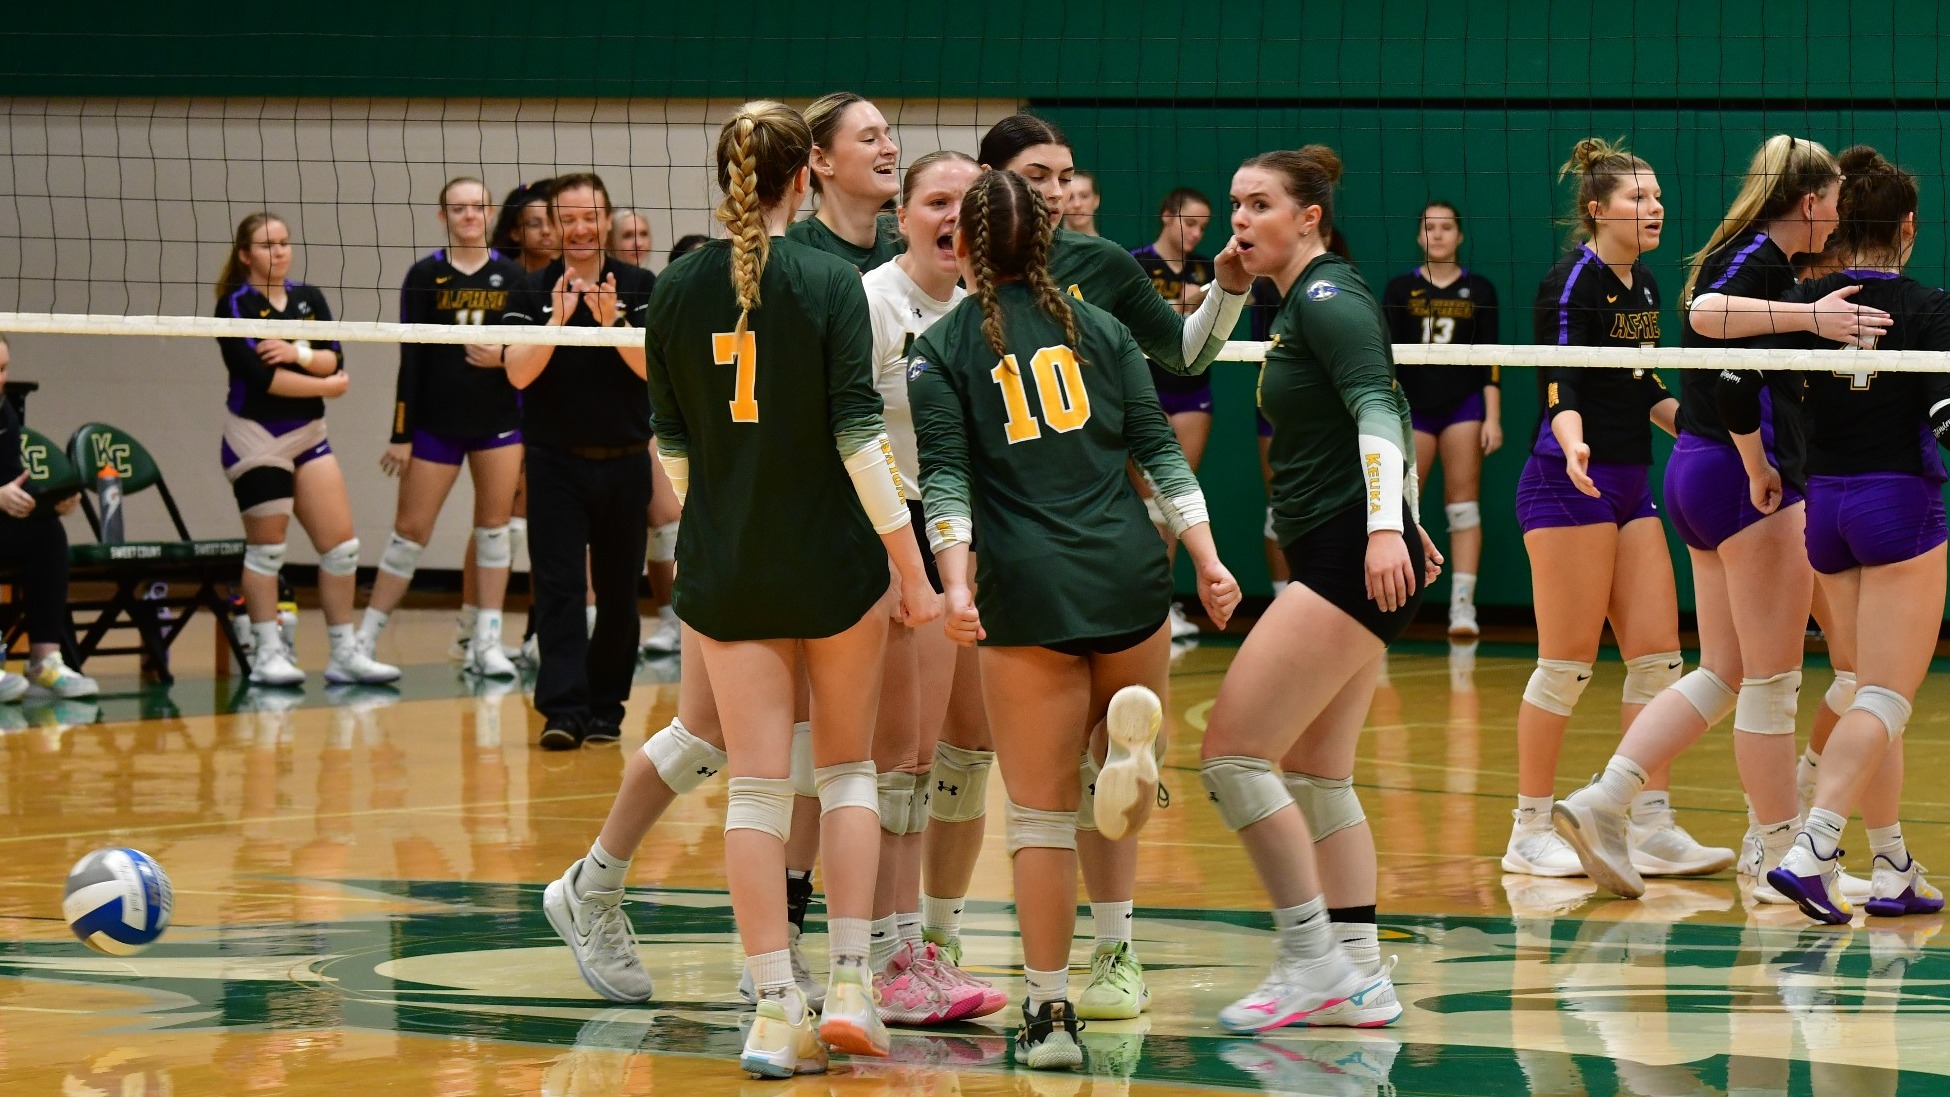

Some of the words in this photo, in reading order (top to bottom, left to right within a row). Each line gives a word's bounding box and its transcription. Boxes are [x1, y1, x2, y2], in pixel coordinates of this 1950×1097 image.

[1421, 316, 1455, 344] 13
[711, 330, 759, 423] 7
[991, 345, 1092, 445] 10
[91, 432, 132, 478] KC
[1365, 453, 1381, 515] KEUKA
